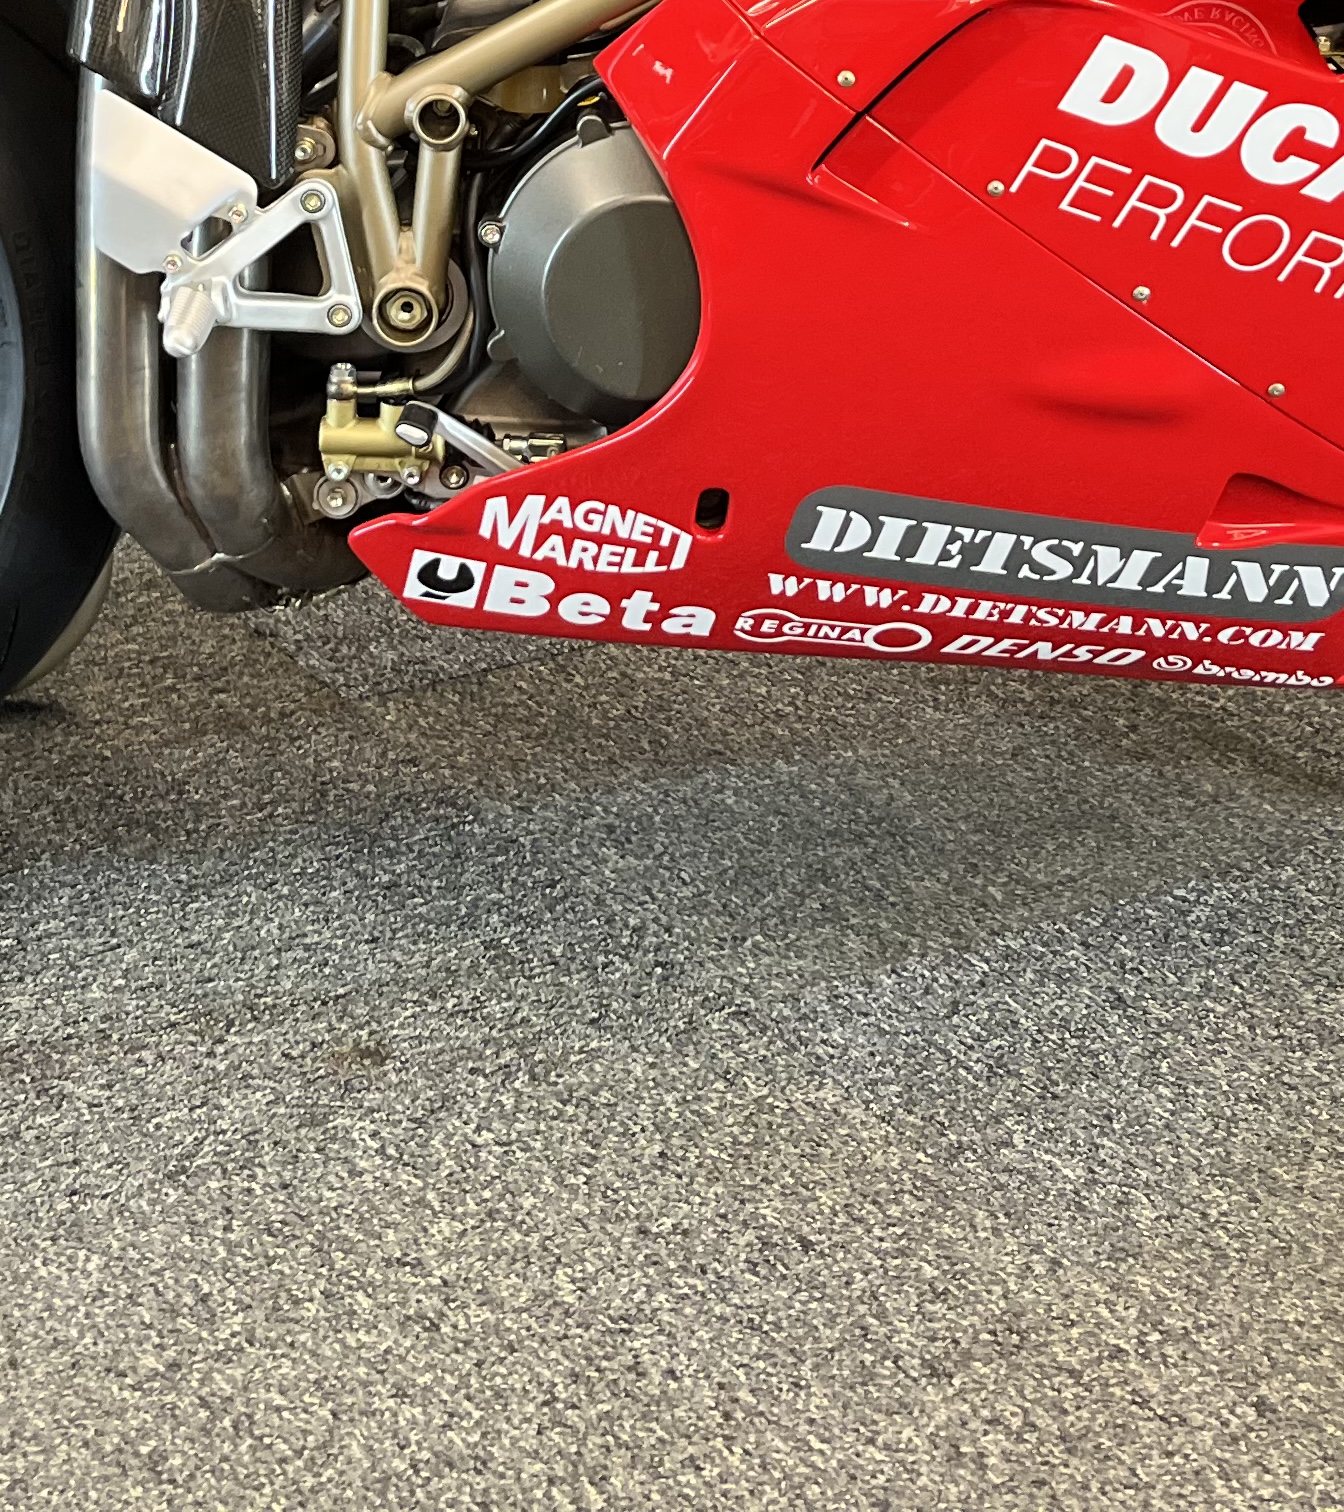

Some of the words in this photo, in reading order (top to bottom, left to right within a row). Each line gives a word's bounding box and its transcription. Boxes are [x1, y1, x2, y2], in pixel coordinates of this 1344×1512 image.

[479, 494, 693, 558] MAGNETI
[483, 564, 716, 637] Beta
[766, 573, 1325, 653] WWW.DIETSMANN.COM
[734, 616, 863, 642] REGINA
[940, 633, 1147, 668] DENSO
[1192, 659, 1334, 687] brembo
